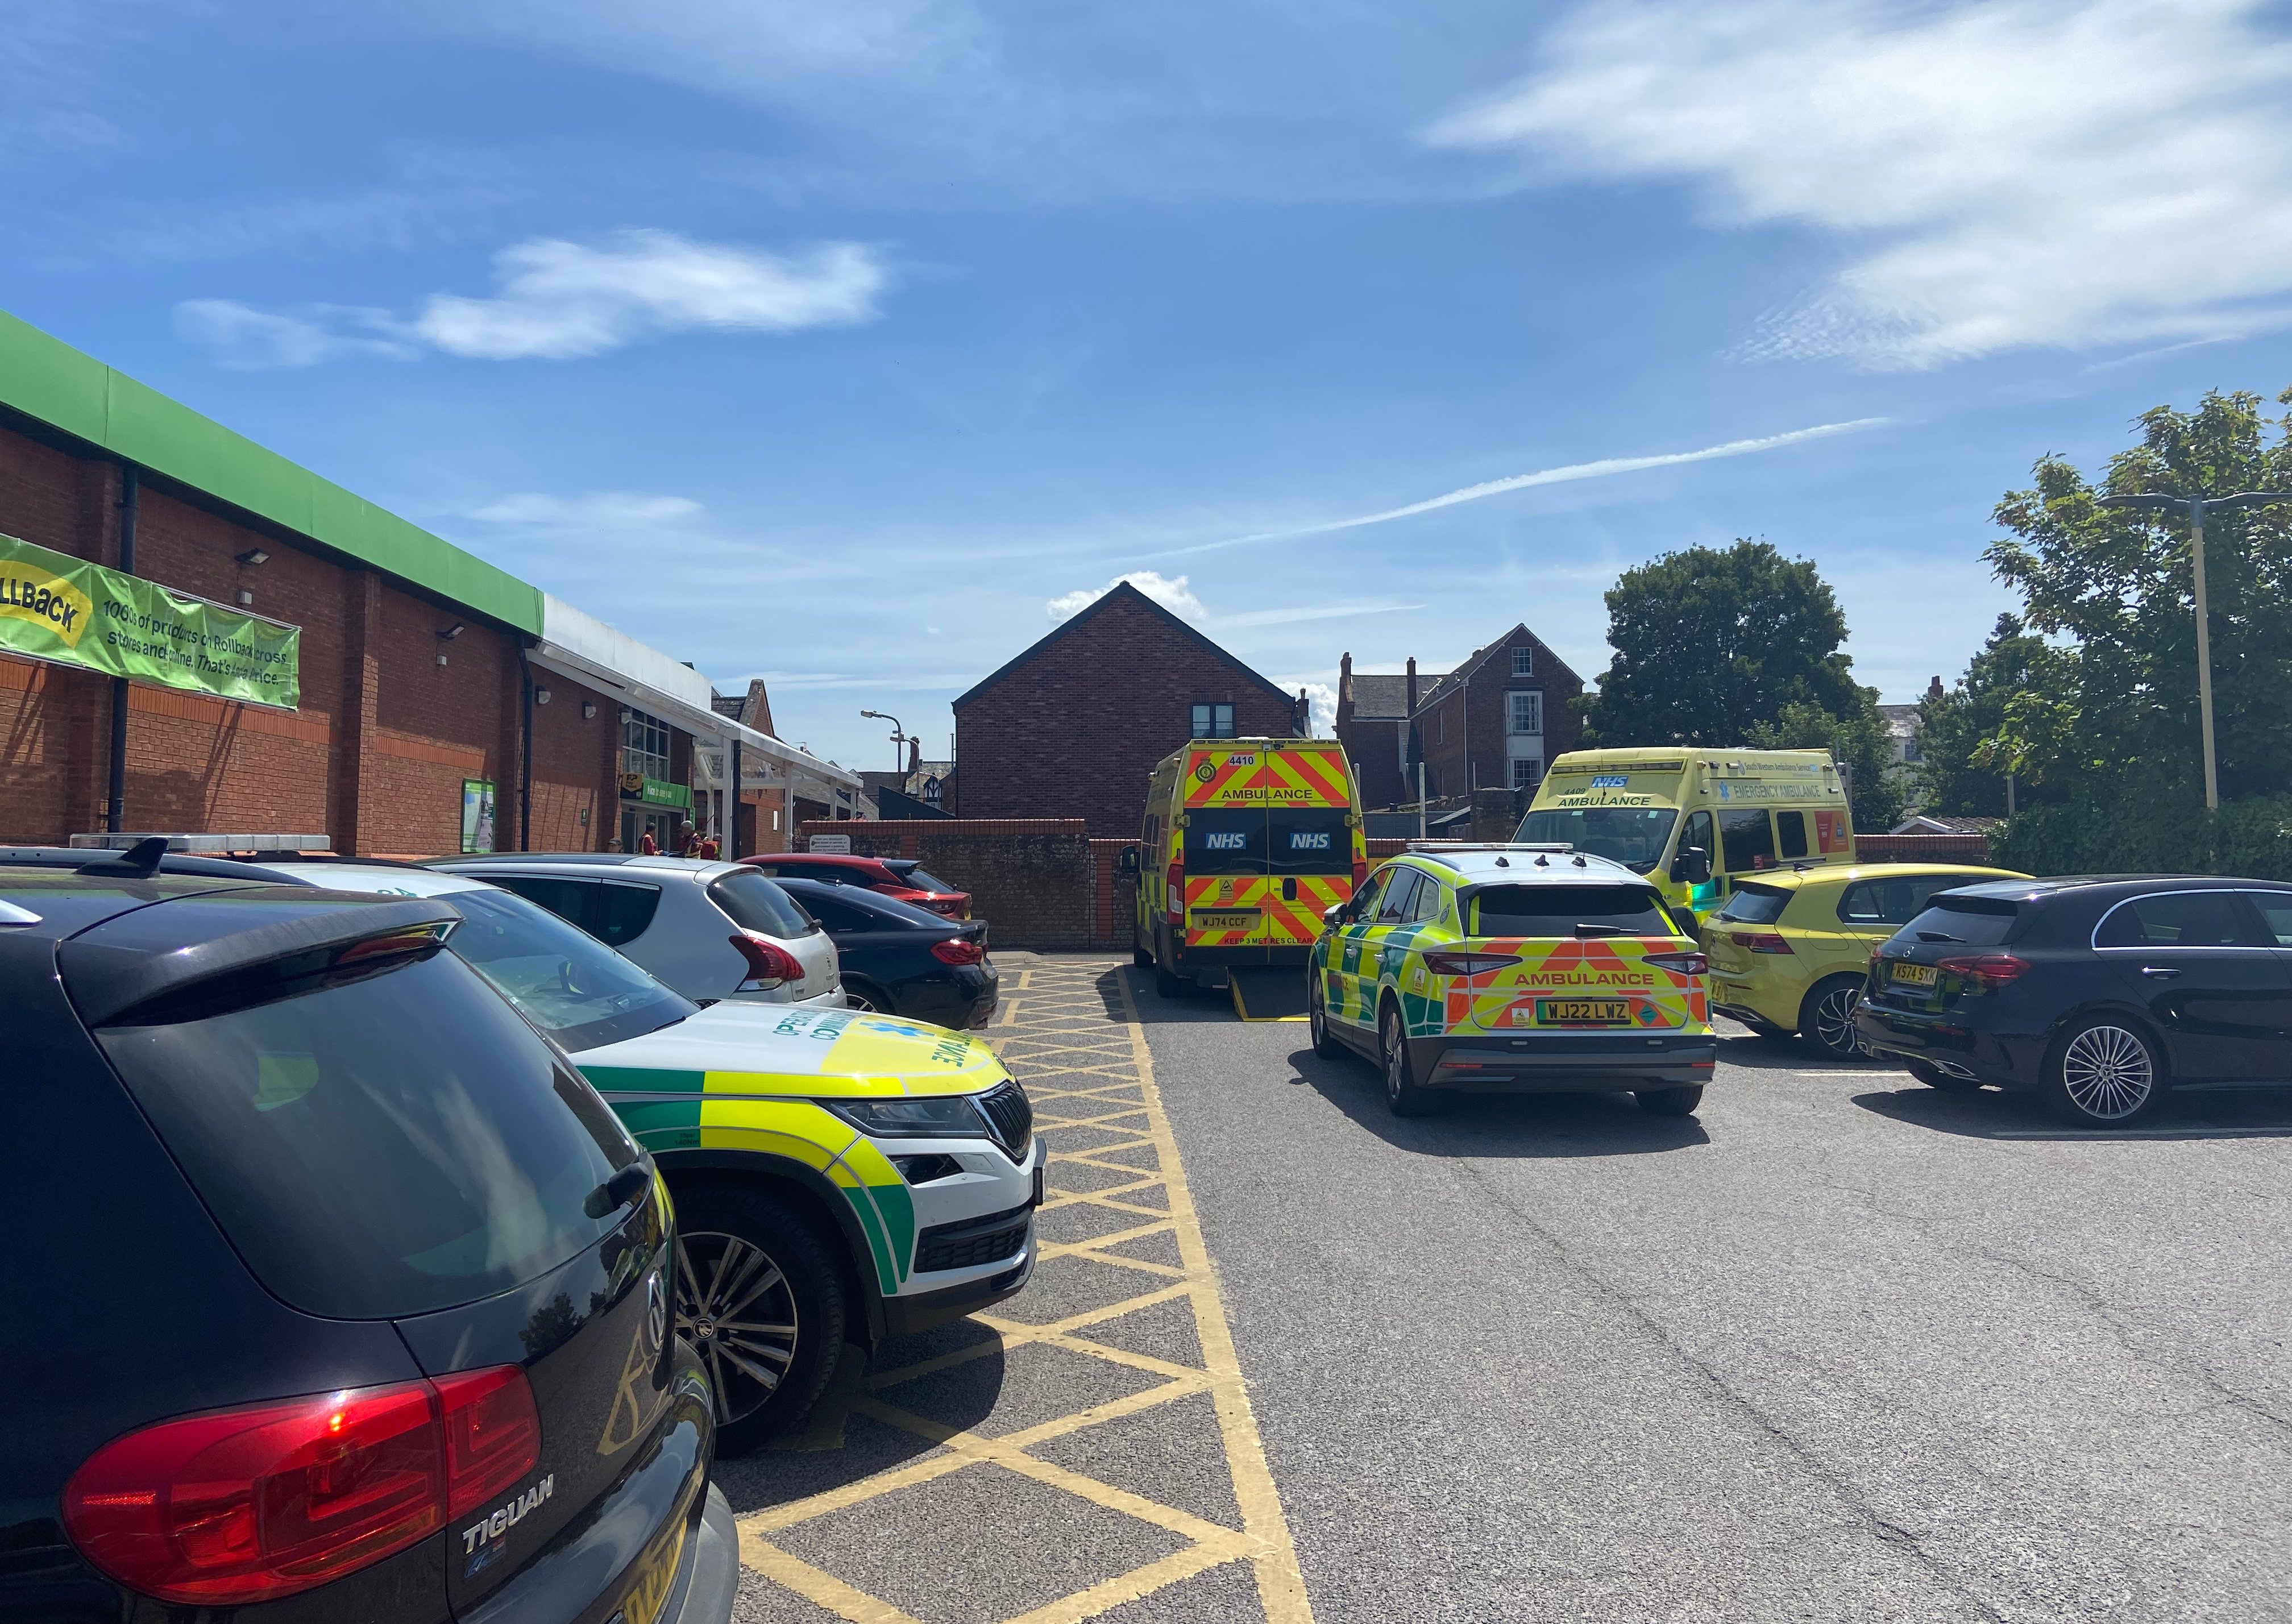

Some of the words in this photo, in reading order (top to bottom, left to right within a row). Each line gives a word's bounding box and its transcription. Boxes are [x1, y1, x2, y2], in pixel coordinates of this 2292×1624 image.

[104, 600, 137, 626] 1000s
[138, 613, 151, 629] of
[201, 634, 211, 649] on
[214, 635, 254, 658] Rollback
[254, 649, 286, 664] cross
[107, 630, 141, 653] stores
[143, 641, 169, 659] and
[197, 654, 231, 675] That's
[249, 667, 279, 685] Price.
[1230, 756, 1254, 765] 4410
[1591, 776, 1628, 787] NHS
[1221, 789, 1313, 799] AMBULANCE
[1734, 785, 1779, 799] EMERGENCY
[1779, 785, 1821, 798] AMBULANCE
[1557, 796, 1651, 807] AMBULANCE
[1207, 834, 1244, 848] NHS
[1292, 834, 1329, 848] NHS
[1202, 917, 1226, 927] WJ74
[1229, 917, 1247, 927] CCF
[1514, 973, 1654, 986] AMBULANCE
[1896, 965, 1917, 979] KS74
[1917, 967, 1937, 982] SXK
[1548, 1004, 1591, 1019] WJ22
[1595, 1004, 1626, 1019] LWZ
[462, 1473, 554, 1555] TIGUAN
